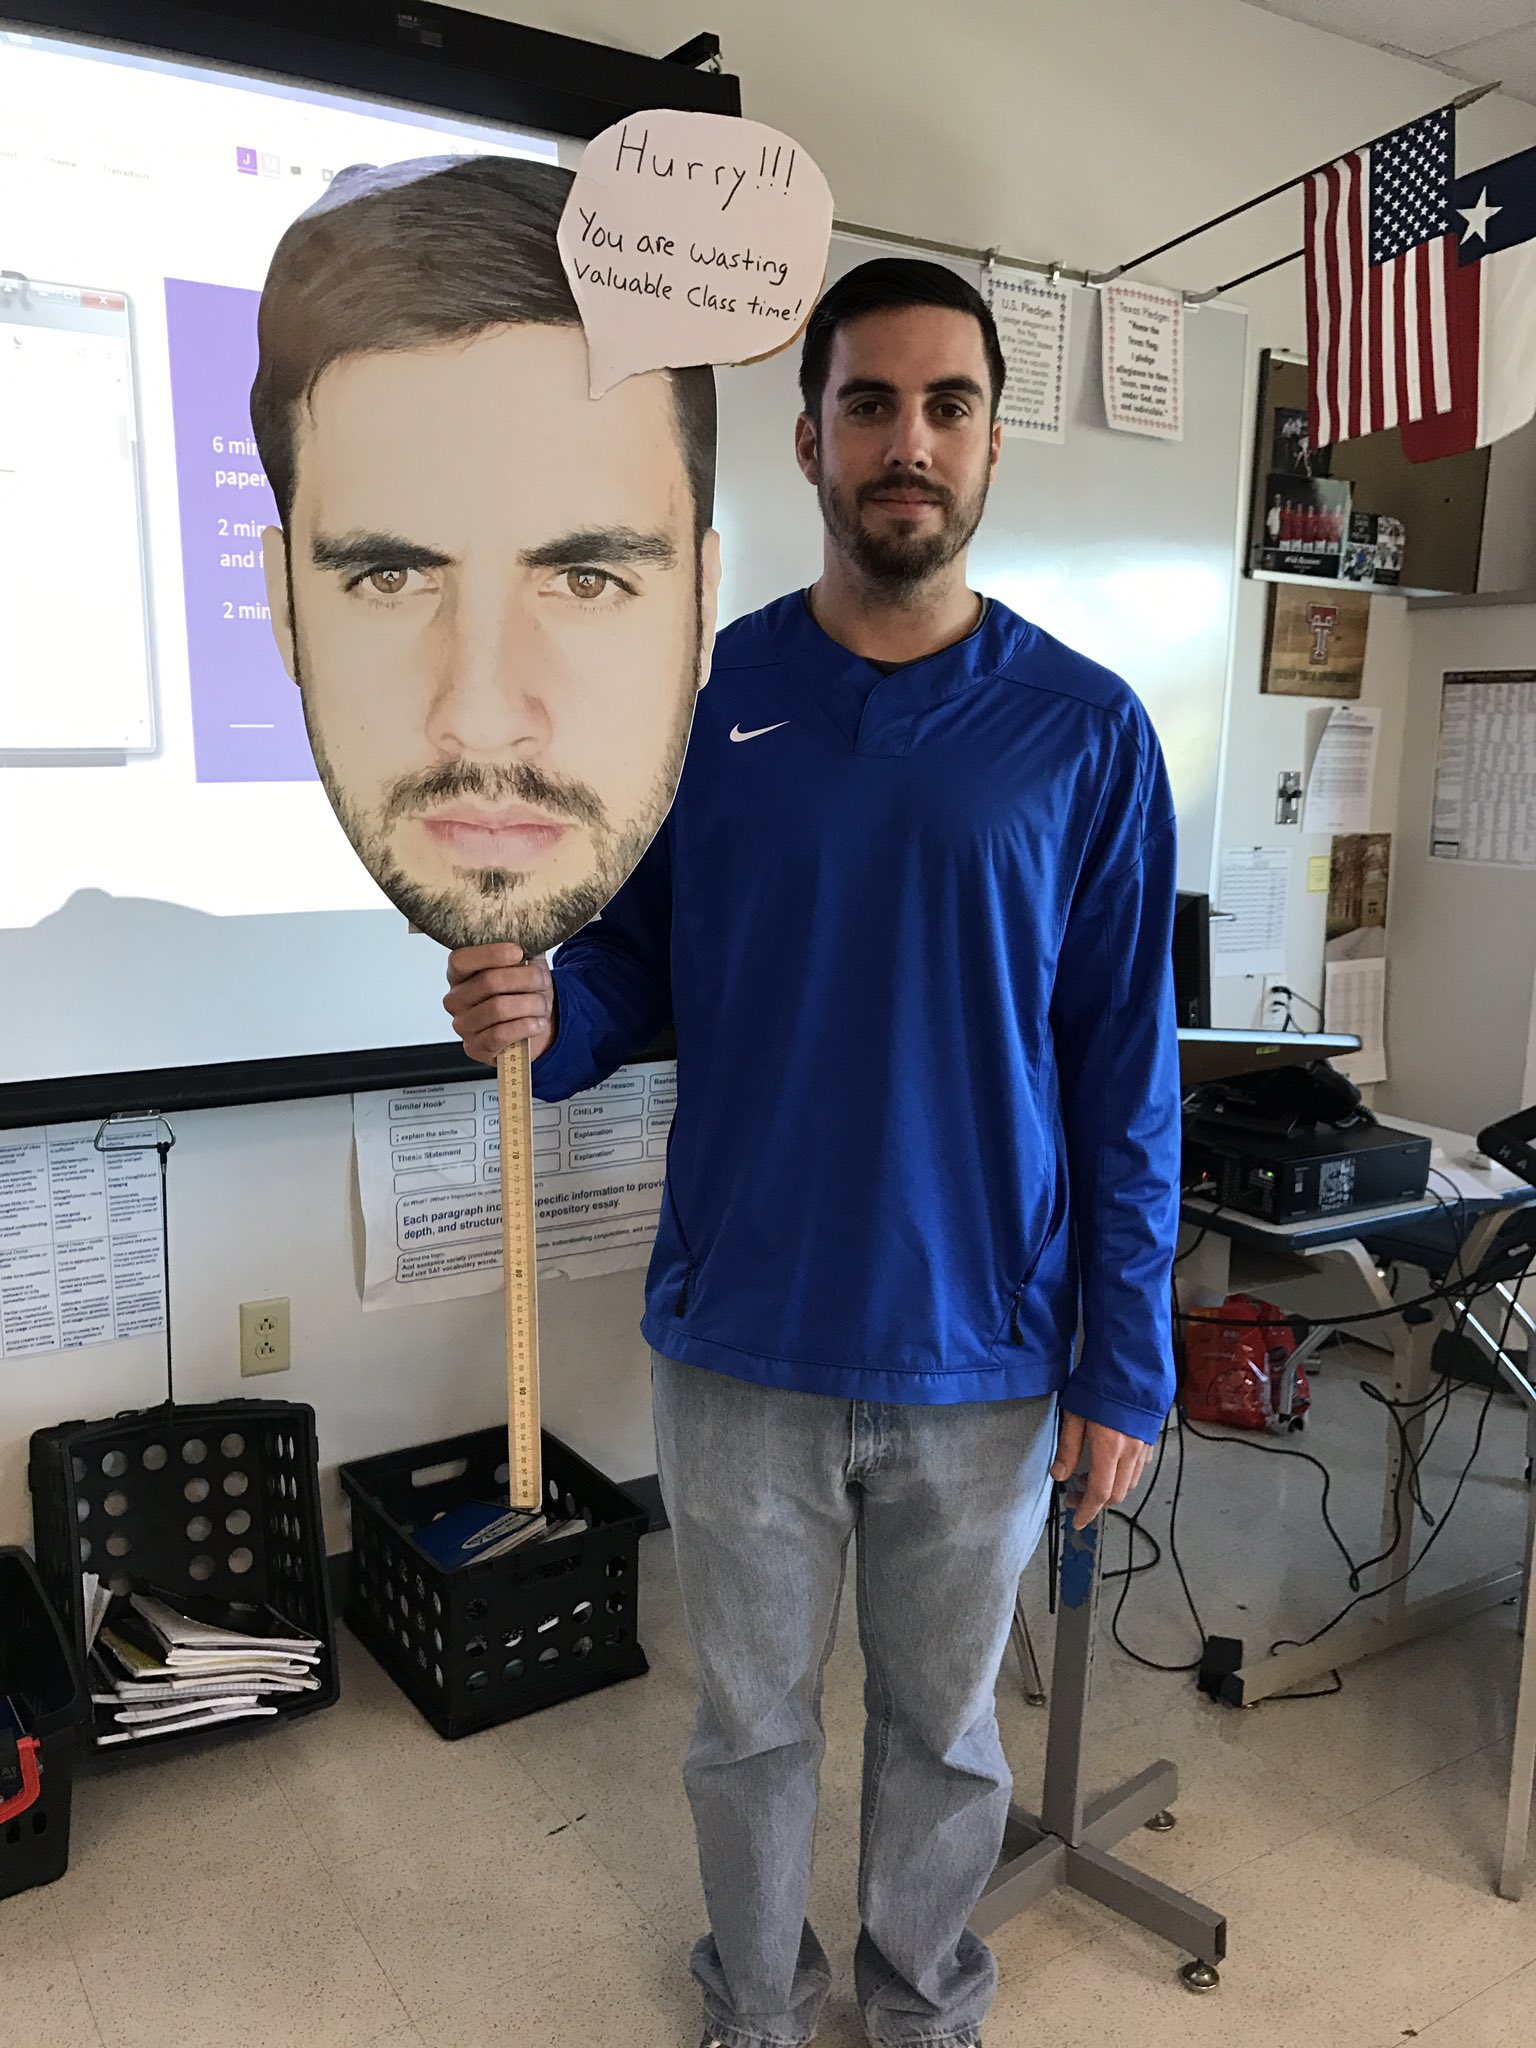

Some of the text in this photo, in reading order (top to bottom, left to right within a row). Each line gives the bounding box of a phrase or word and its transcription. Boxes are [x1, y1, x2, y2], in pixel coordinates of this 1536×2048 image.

[616, 124, 795, 211] Hurry!!!
[579, 207, 623, 253] You
[636, 234, 675, 256] are
[747, 296, 802, 321] time!
[212, 436, 223, 453] 6
[218, 518, 228, 536] 2
[220, 550, 255, 568] and
[223, 601, 234, 619] 2
[611, 1082, 635, 1090] reason
[573, 1107, 604, 1116] CHELPS
[401, 1133, 425, 1141] explain
[438, 1129, 458, 1137] simile
[574, 1129, 613, 1139] Explanation
[398, 1149, 462, 1162] Thesis Statement
[403, 1213, 428, 1226] Each
[431, 1205, 483, 1223] paragraph
[572, 1185, 625, 1201] information
[627, 1182, 636, 1191] to
[404, 1226, 435, 1240] depth,
[438, 1222, 457, 1233] and
[539, 1203, 590, 1218] expository
[592, 1198, 620, 1210] essay.
[402, 1271, 414, 1279] and
[442, 1261, 475, 1272] vocabulary
